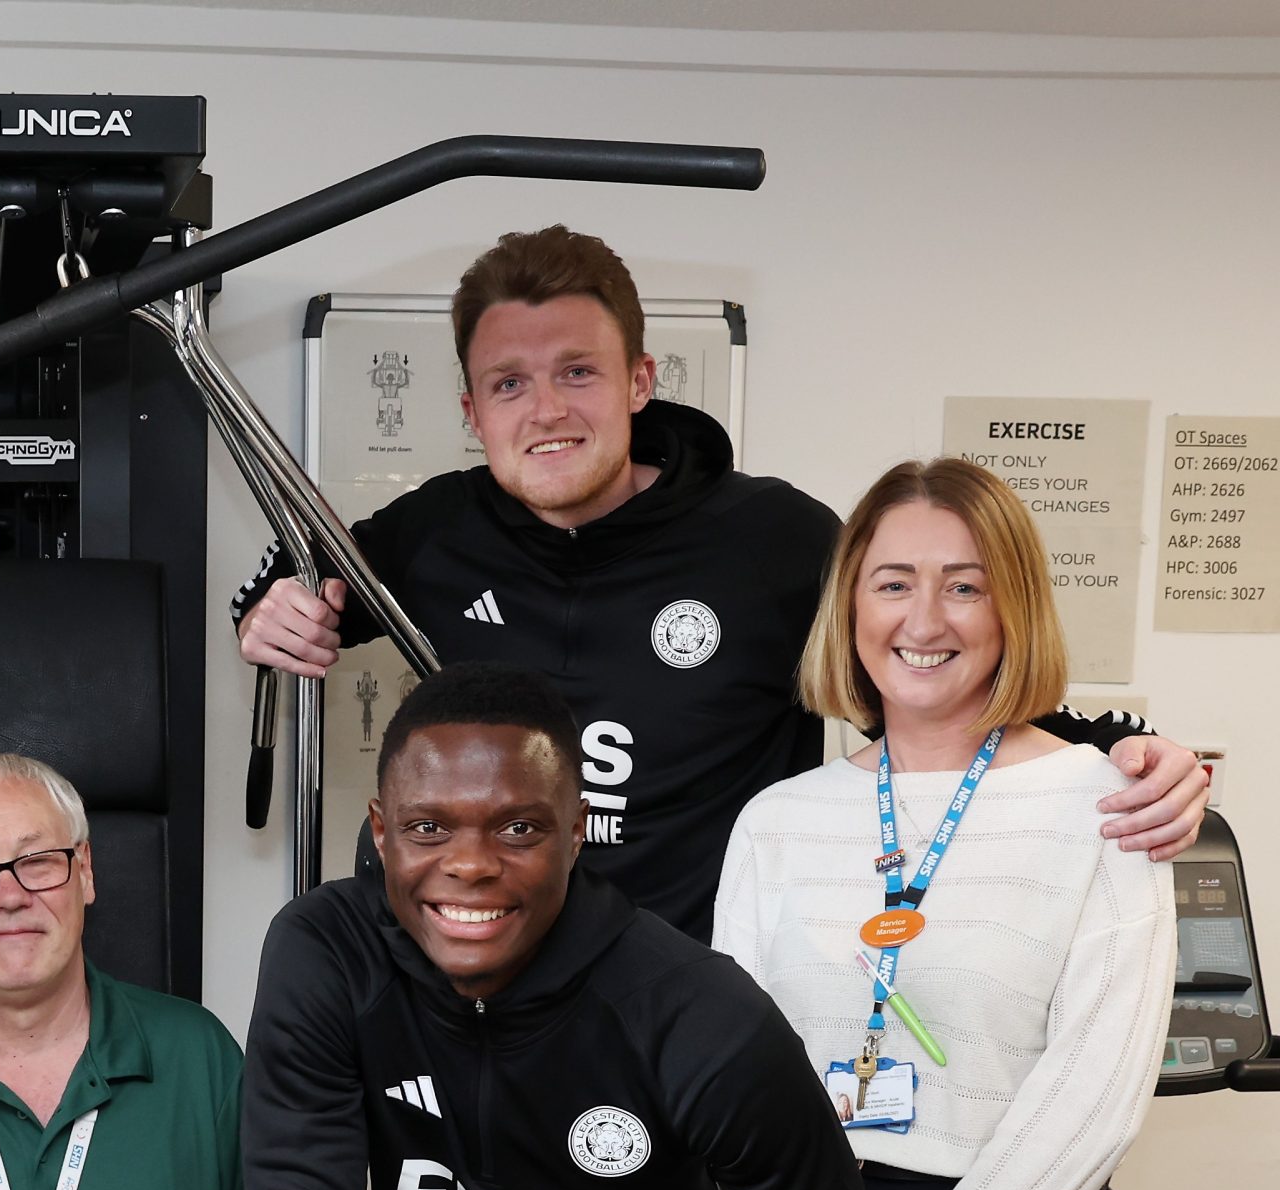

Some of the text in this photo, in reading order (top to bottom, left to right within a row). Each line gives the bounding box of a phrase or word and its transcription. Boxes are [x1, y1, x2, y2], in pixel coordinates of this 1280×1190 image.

[988, 422, 1085, 440] EXERCISE
[1176, 431, 1247, 446] OT Spaces
[1002, 456, 1047, 467] ONLY
[1174, 456, 1278, 472] OT: 2669/2062
[1044, 479, 1088, 490] YOUR
[1172, 483, 1245, 496] AHP: 2626
[1031, 500, 1110, 512] CHANGES
[1170, 509, 1245, 524] Gym: 2497
[1168, 535, 1241, 548] A&P: 2688
[1052, 553, 1095, 565] YOUR
[1166, 561, 1237, 574] HPC: 3006
[1075, 575, 1118, 587] YOUR
[1164, 586, 1265, 600] Forensic: 3027
[660, 606, 714, 636] LEICESTER CITY
[658, 633, 713, 662] FOOTBALL CLUB
[879, 763, 888, 785] NHS
[968, 757, 988, 781] NHS
[880, 791, 891, 814] NHS
[952, 786, 971, 813] NHS
[883, 821, 895, 844] NHS
[936, 819, 955, 845] NHS
[879, 853, 901, 868] NHS
[920, 851, 940, 877] NHS
[880, 919, 906, 927] Service
[876, 927, 907, 935] Manager
[577, 1113, 643, 1144] LEICESTER CITY
[71, 1145, 84, 1169] NHS
[576, 1144, 644, 1170] FOOTBALL CLUB
